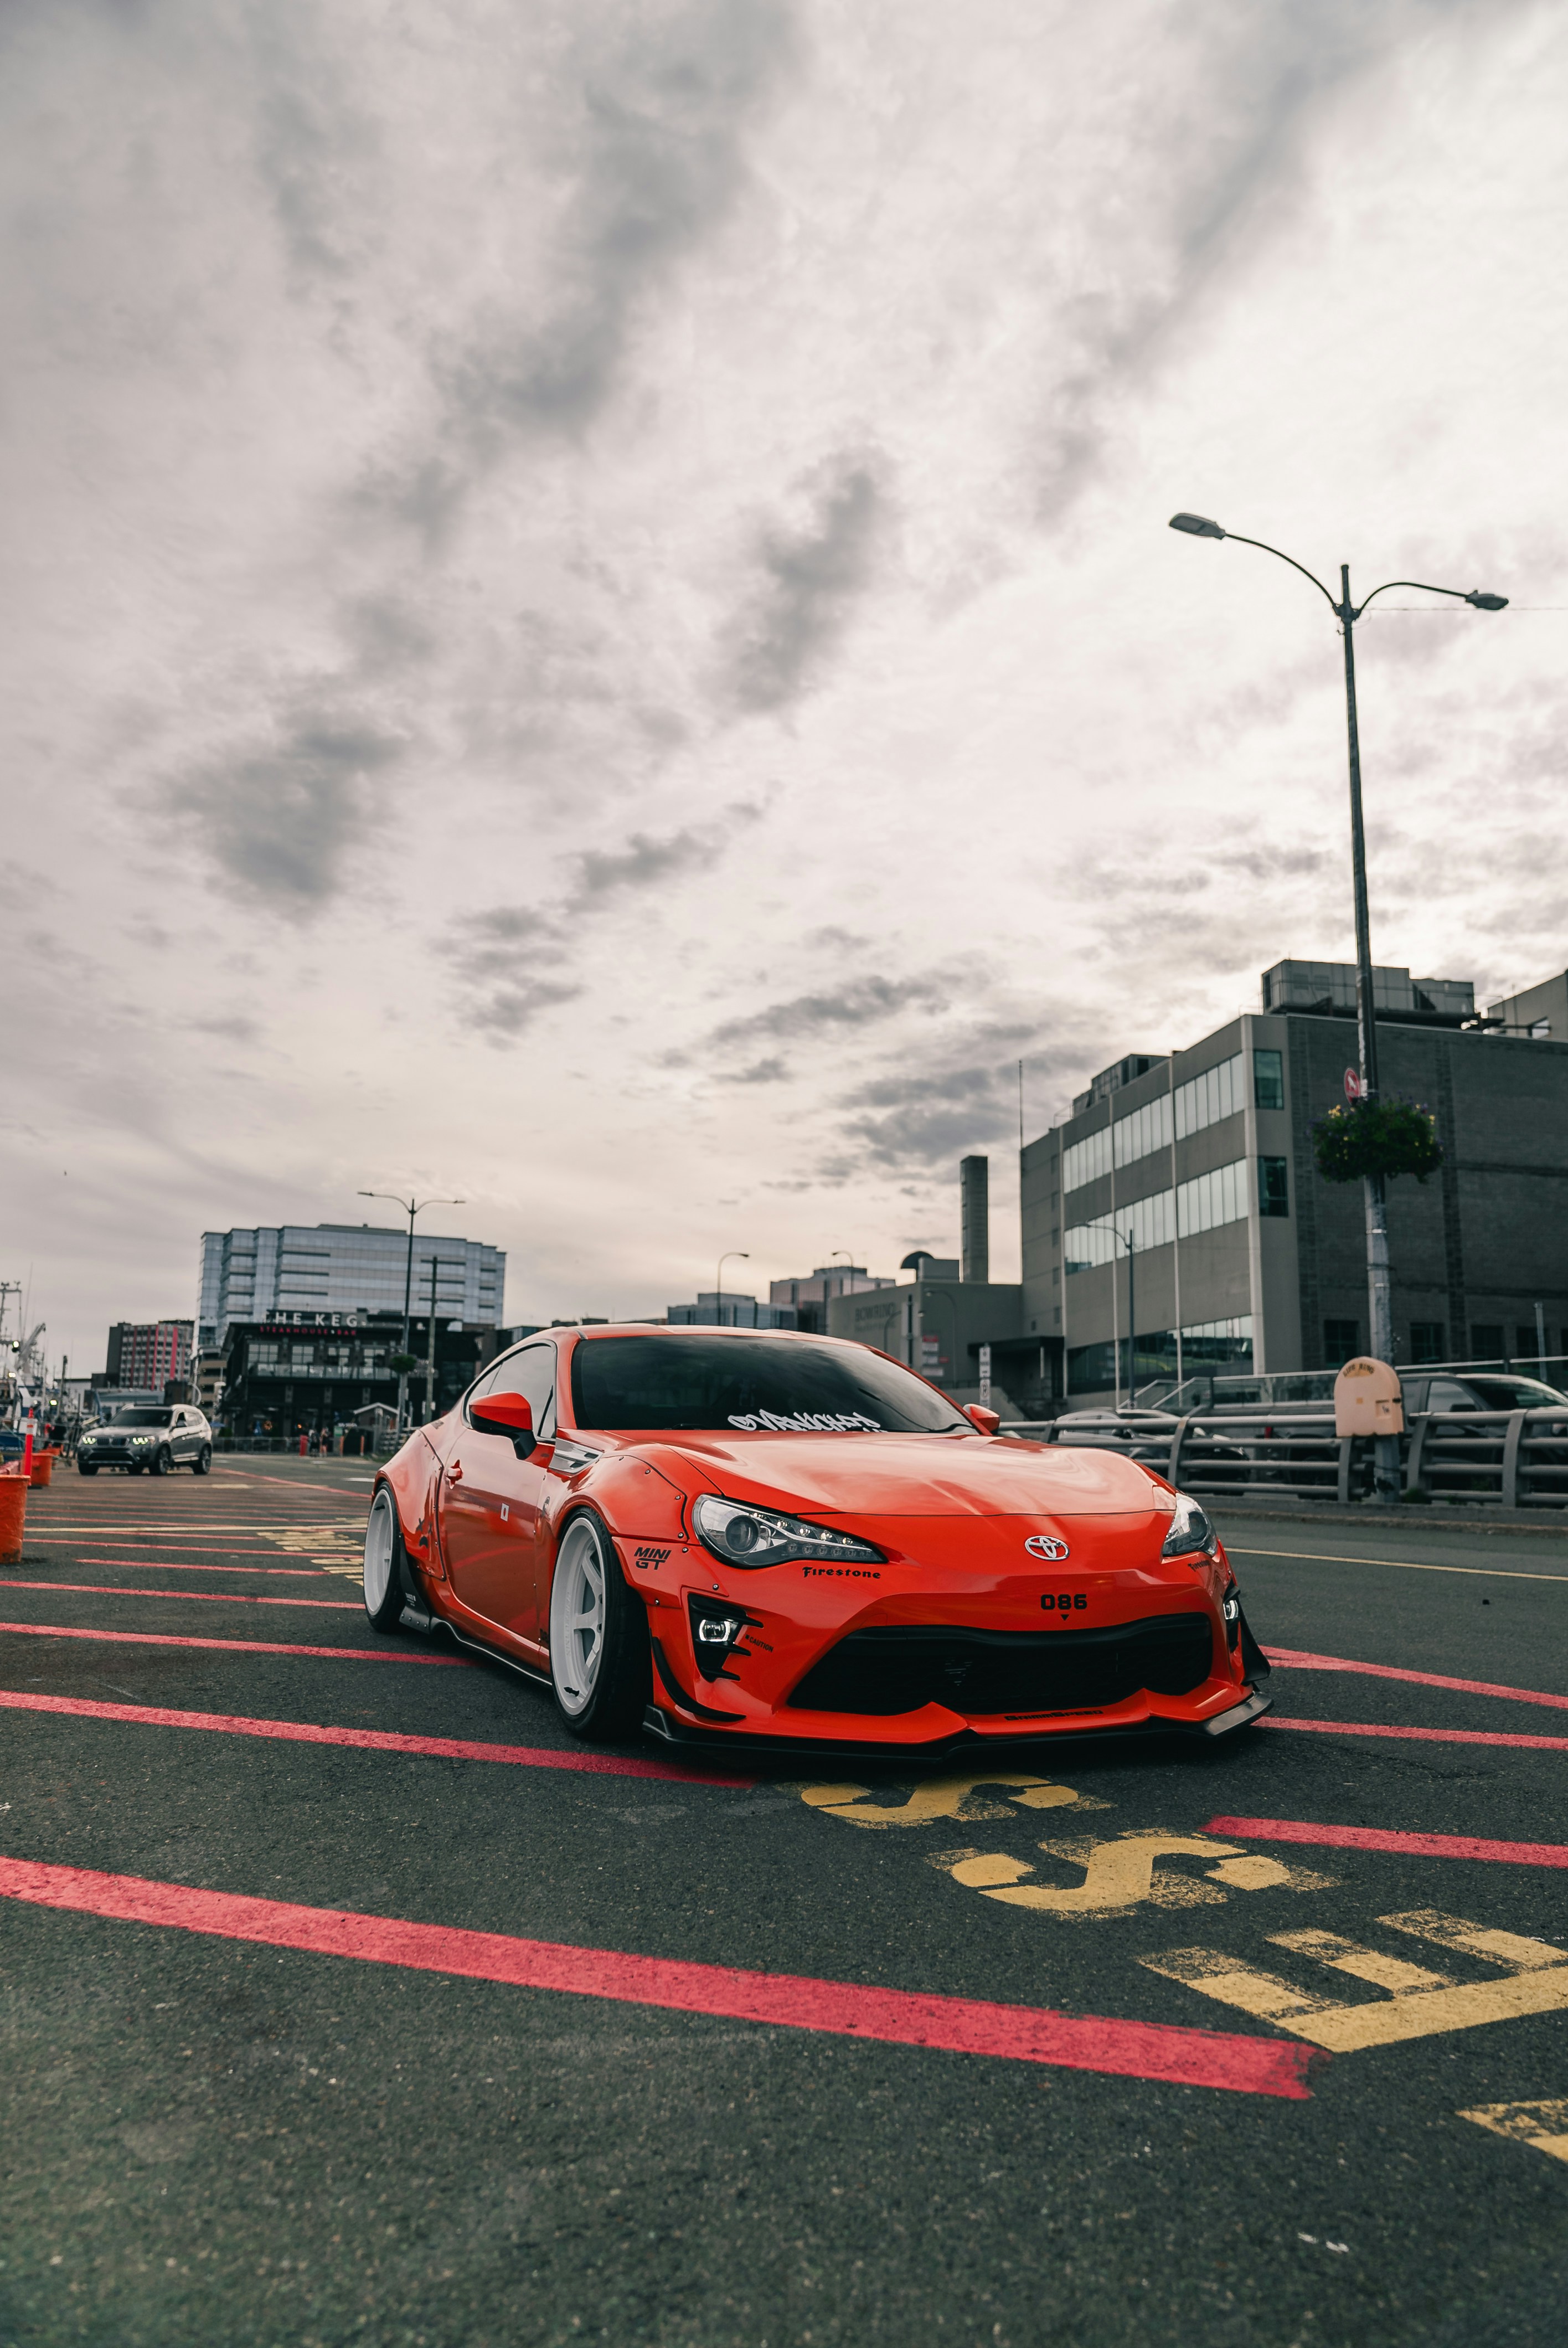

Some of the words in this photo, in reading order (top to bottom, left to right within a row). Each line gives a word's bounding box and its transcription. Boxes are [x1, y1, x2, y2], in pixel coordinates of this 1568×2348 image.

[261, 1311, 302, 1325] THE
[260, 1326, 328, 1335] STEAKHOUSE
[1343, 1363, 1355, 1377] LIFE
[1359, 1363, 1374, 1374] RING
[634, 1547, 672, 1559] MINI
[636, 1557, 666, 1570] GT
[802, 1567, 881, 1579] Firestone
[1041, 1594, 1087, 1610] 086
[749, 1636, 774, 1652] CAUTION
